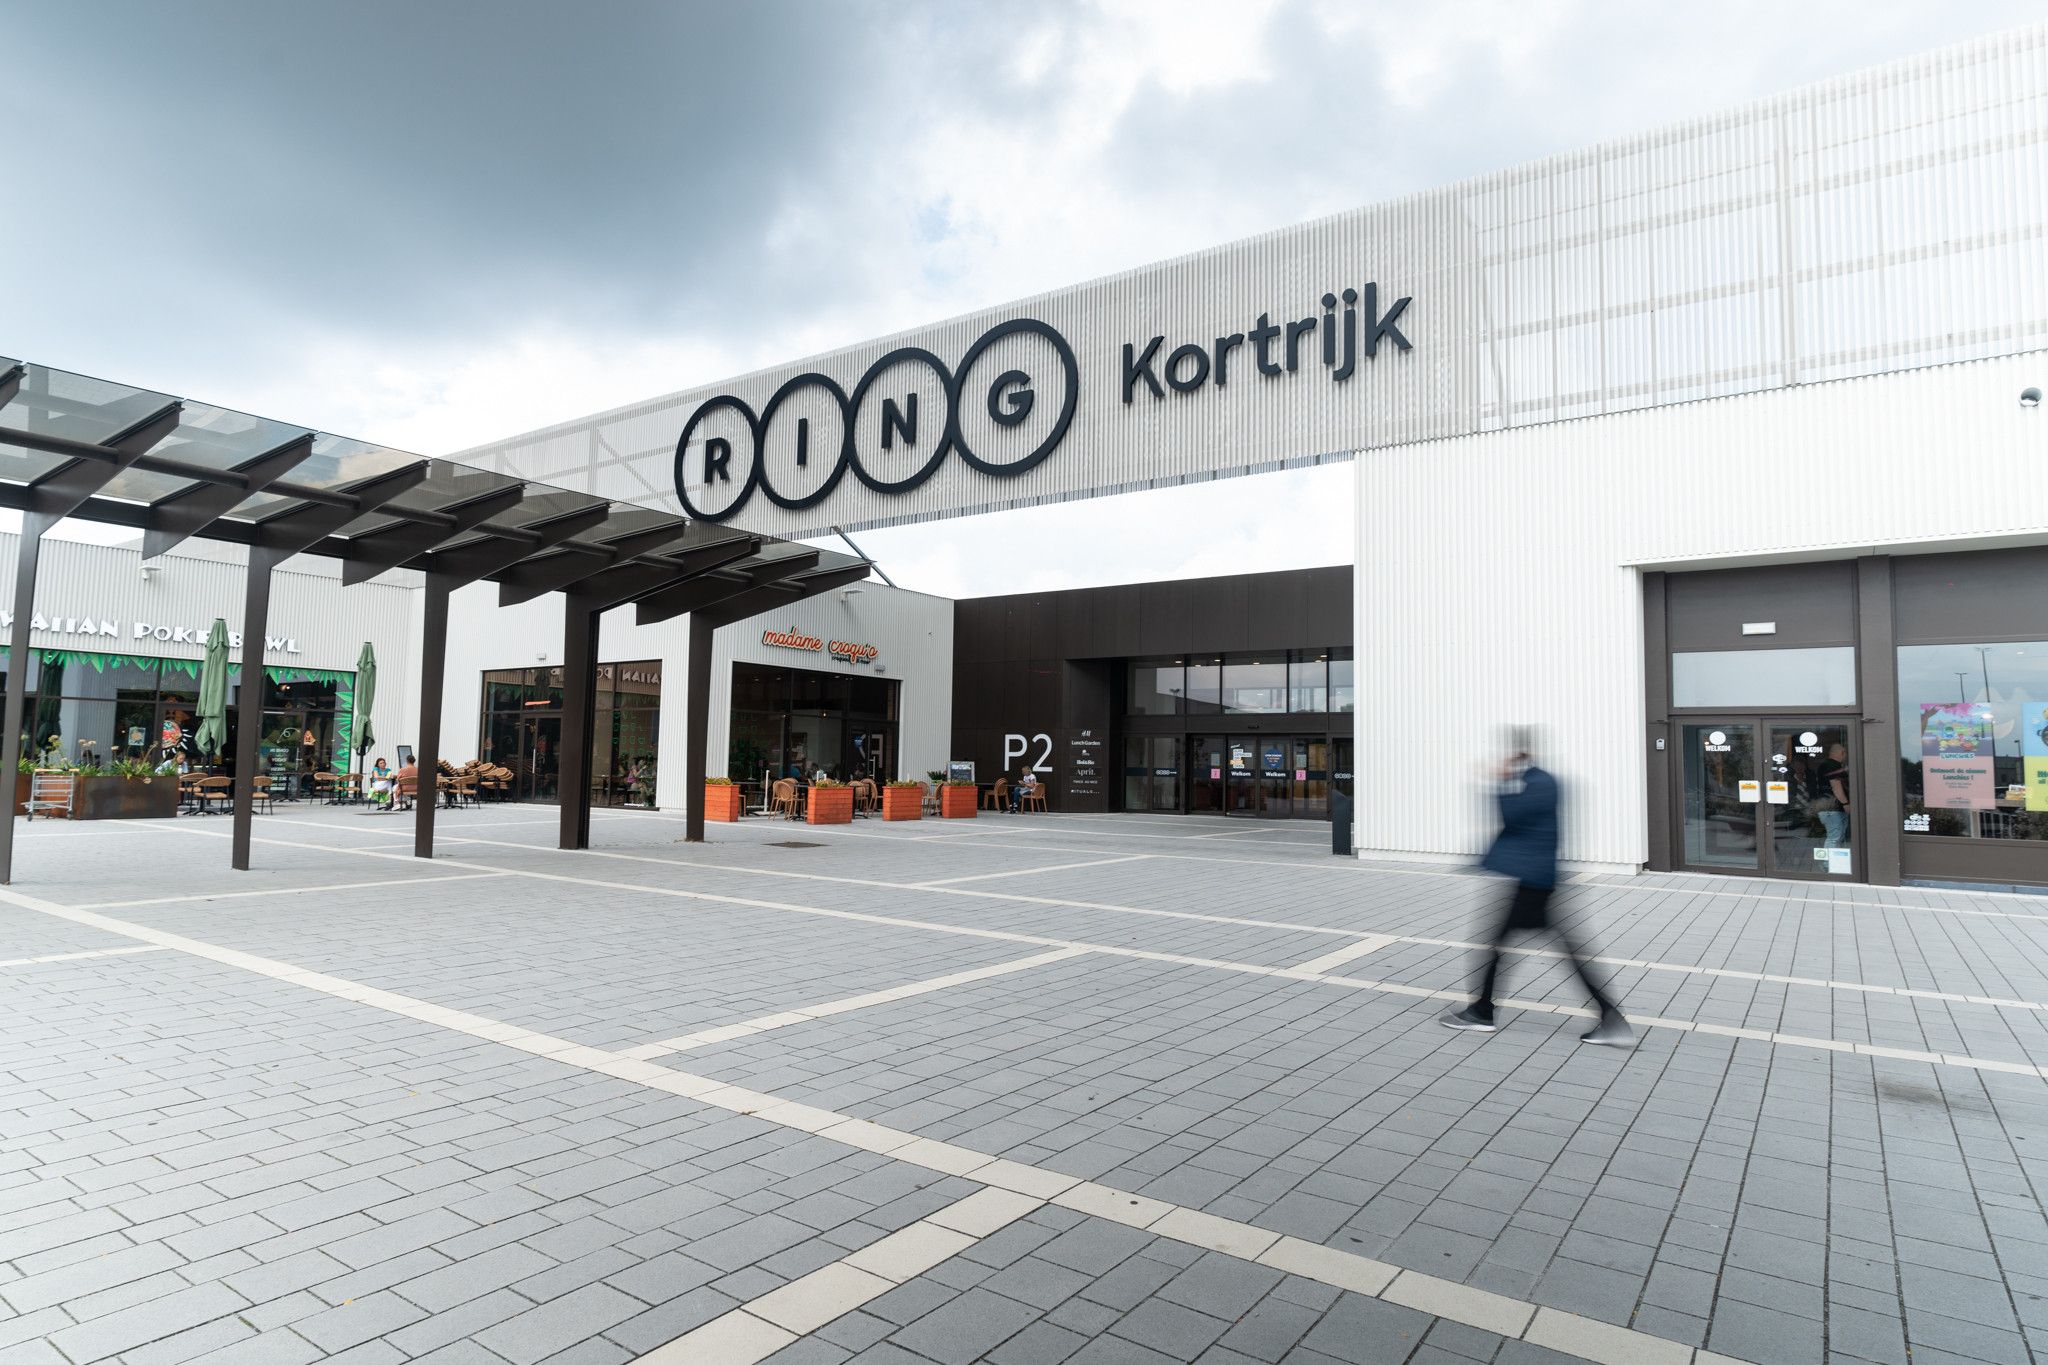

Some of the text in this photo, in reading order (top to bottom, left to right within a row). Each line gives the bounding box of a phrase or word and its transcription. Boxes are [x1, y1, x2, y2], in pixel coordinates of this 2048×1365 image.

[704, 282, 1414, 484] RING Kortrijk
[228, 630, 301, 653] BWL
[762, 625, 823, 652] madame
[1004, 733, 1053, 772] P2
